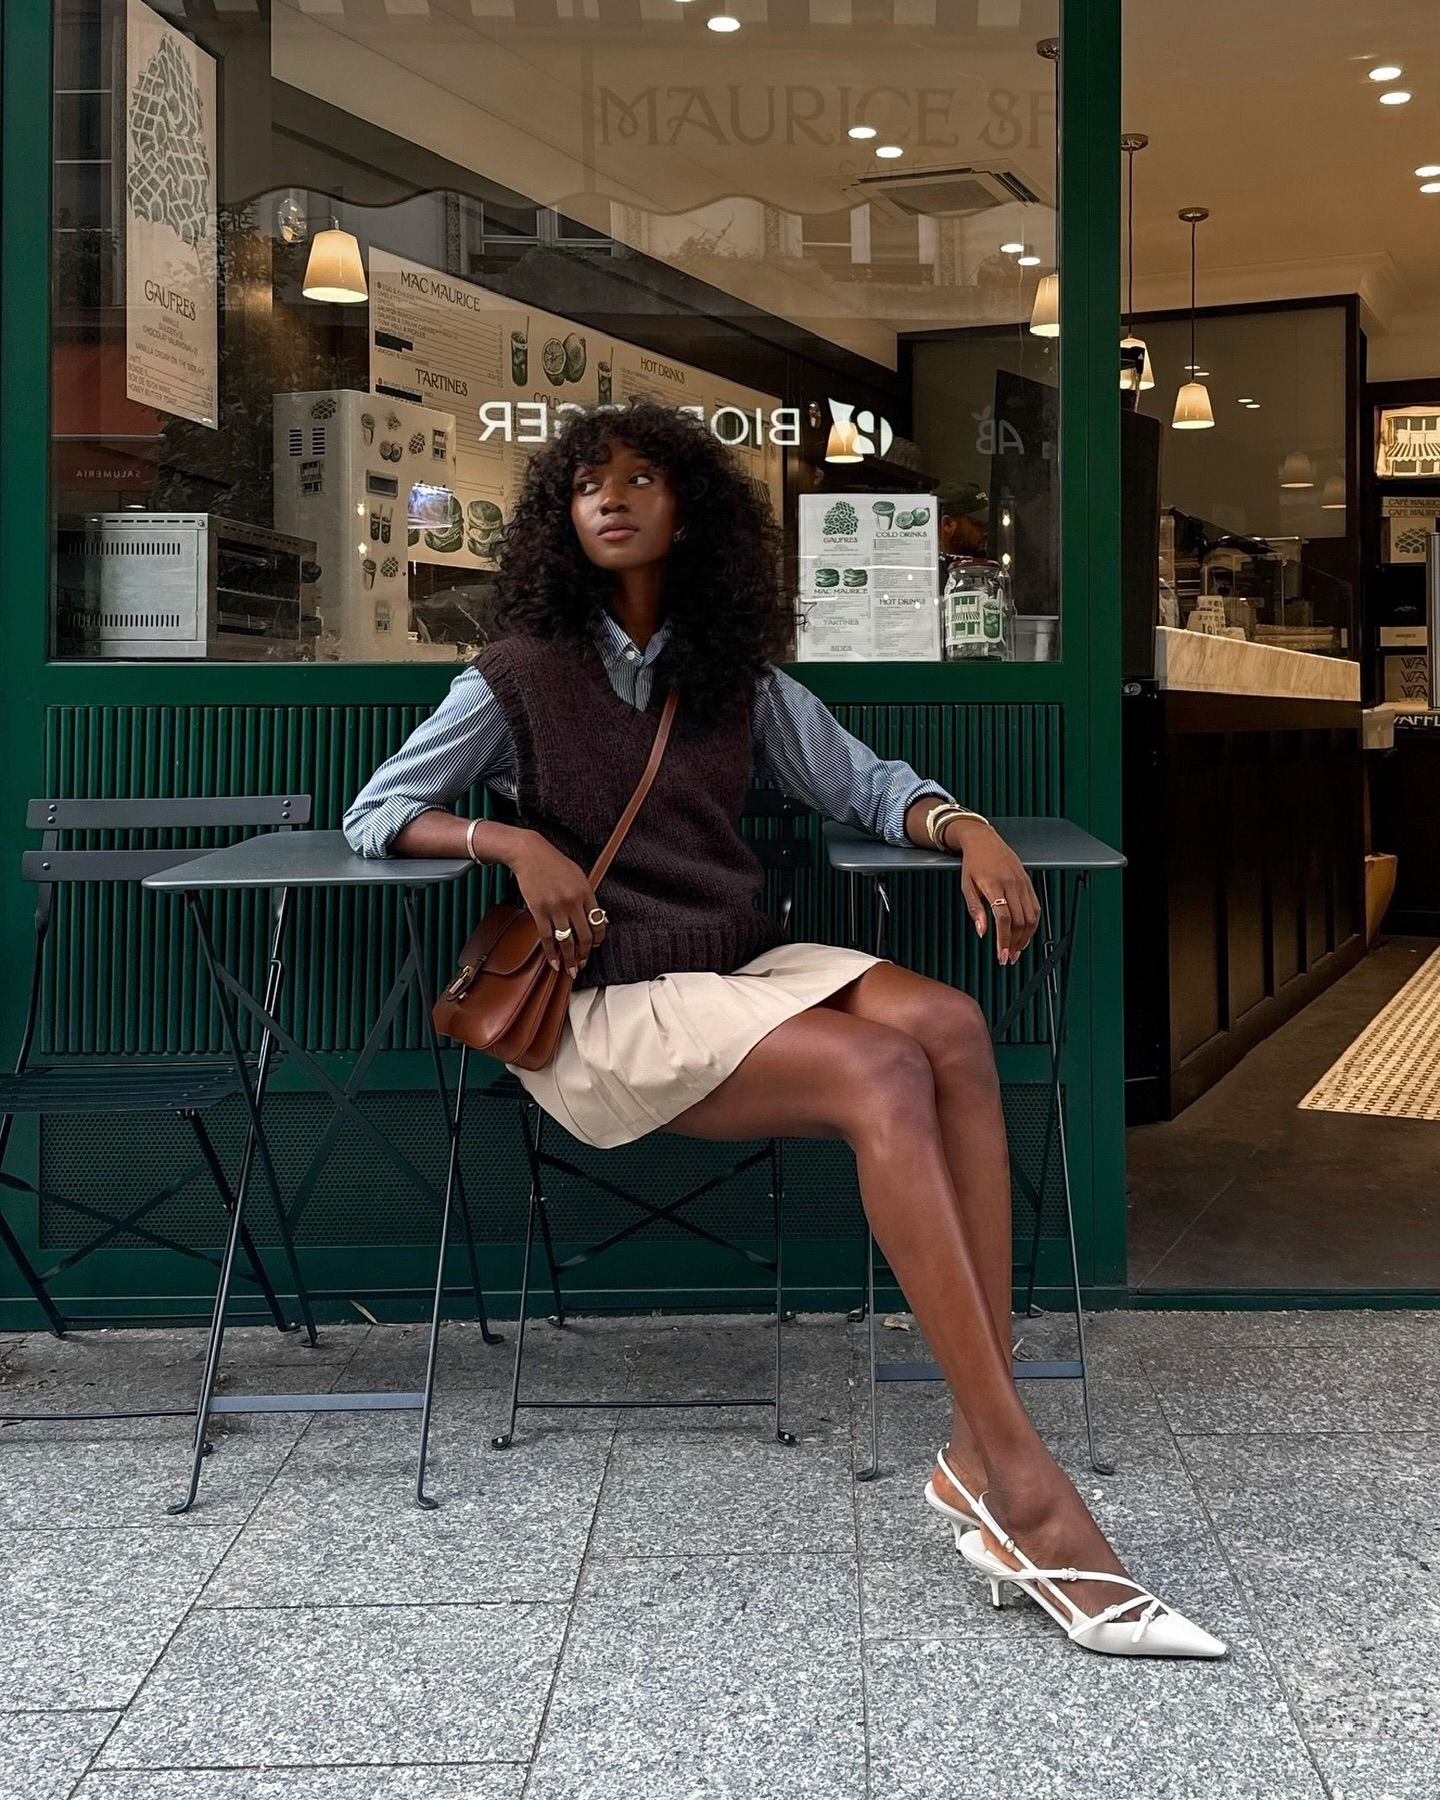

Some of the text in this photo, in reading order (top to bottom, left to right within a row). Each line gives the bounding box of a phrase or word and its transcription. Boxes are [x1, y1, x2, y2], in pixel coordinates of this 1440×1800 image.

[600, 84, 960, 147] MAURICE
[144, 279, 197, 321] GAUFRES
[401, 270, 428, 293] MAC
[430, 281, 480, 312] MAURICE
[415, 368, 468, 397] TARTINES
[640, 357, 657, 375] HOT
[658, 363, 686, 385] DRINKS
